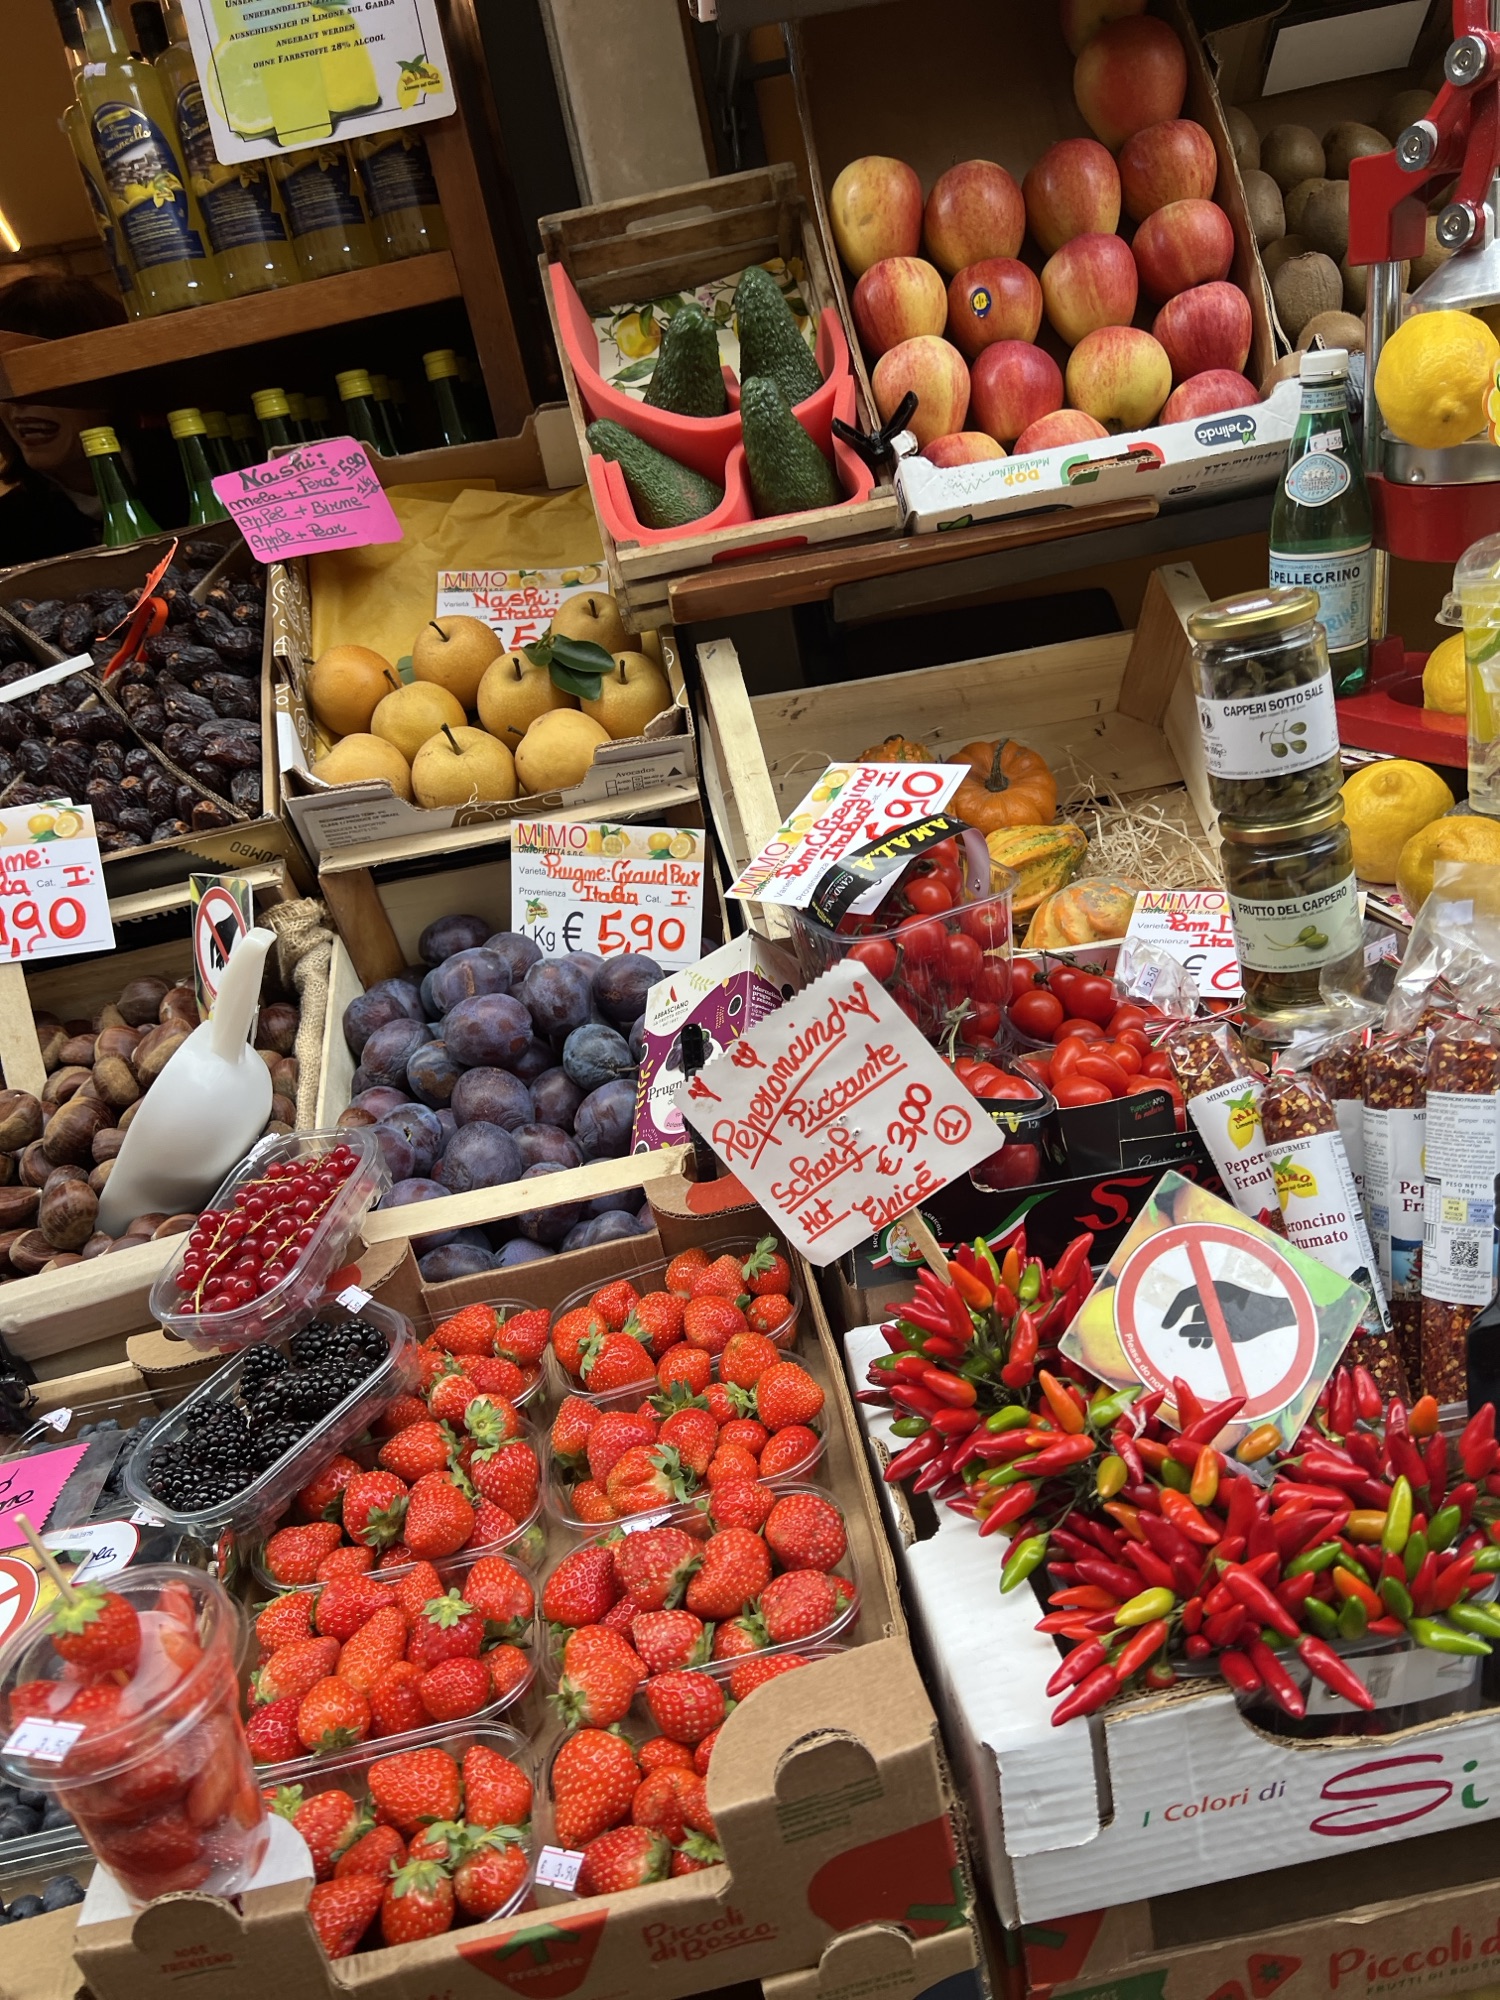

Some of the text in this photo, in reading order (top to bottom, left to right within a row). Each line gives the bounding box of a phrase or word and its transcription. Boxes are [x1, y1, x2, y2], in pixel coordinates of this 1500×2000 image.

[1004, 467, 1040, 486] DOP
[444, 572, 508, 588] MIMO
[472, 586, 560, 609] Nashi:
[1223, 683, 1325, 717] CAPPERI SOTTO SALE
[615, 767, 656, 778] Avocados
[518, 823, 588, 849] MIMO
[519, 867, 547, 876] Varietà
[732, 842, 789, 895] MIMO
[795, 861, 830, 902] Provenienza
[518, 887, 567, 898] Provenienza
[580, 885, 639, 905] Italia
[645, 894, 662, 904] Cat.
[1143, 893, 1225, 910] MIMO
[1238, 886, 1347, 917] FRUTTO DEL CAPPERO
[598, 909, 685, 955] 5,90
[649, 1081, 682, 1099] Prugn
[1205, 1089, 1230, 1104] MIMO
[1273, 1141, 1311, 1158] GOURMET
[1464, 1181, 1488, 1189] NETTO
[798, 1197, 834, 1235] Hot
[923, 1212, 943, 1236] AGRICOLA
[1287, 1211, 1346, 1233] eroncino
[1124, 1333, 1165, 1391] Please do not
[1164, 1788, 1249, 1822] Colori
[1258, 1780, 1287, 1802] di
[642, 1906, 744, 1947] Piccoli
[651, 1938, 677, 1962] di
[1329, 1925, 1473, 1990] Piccoli
